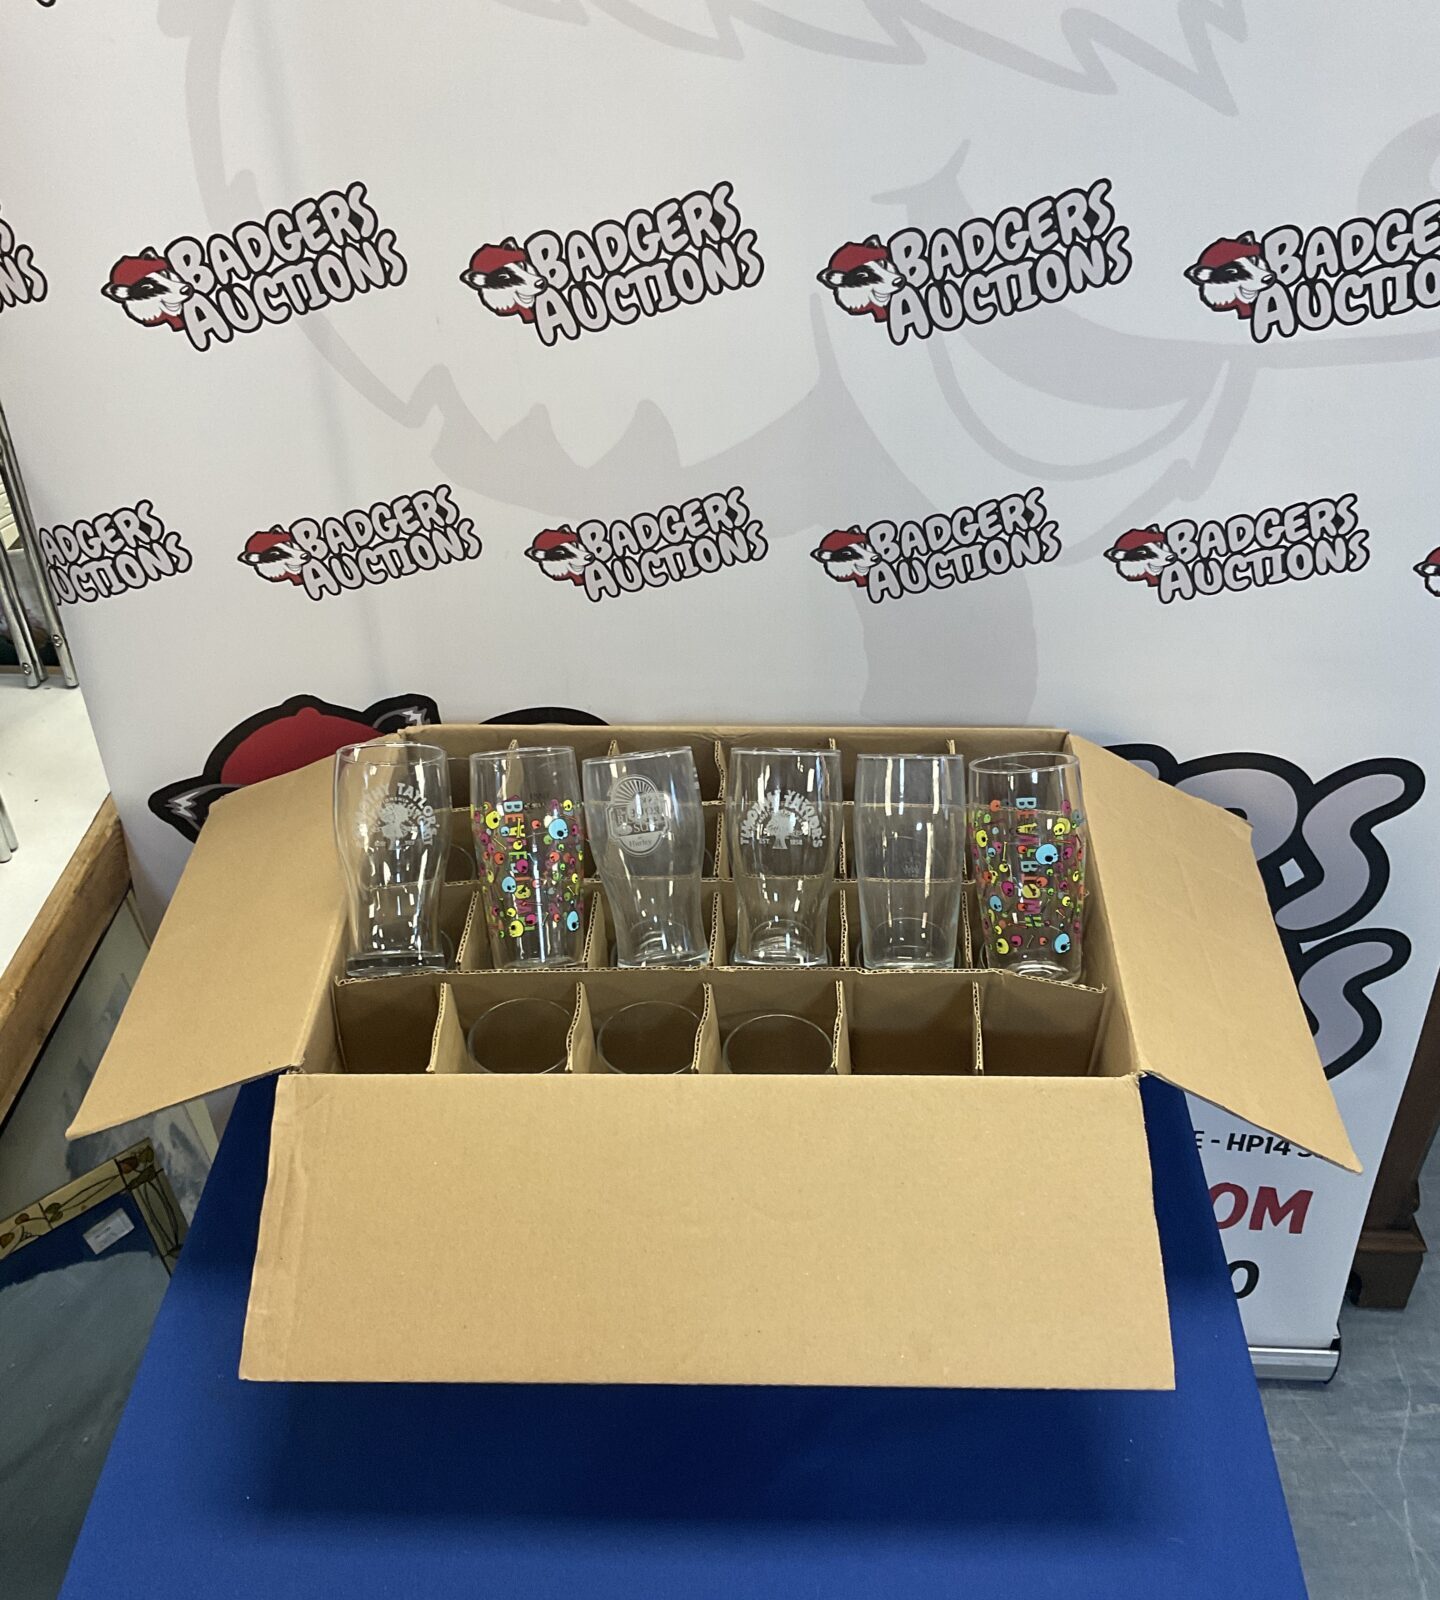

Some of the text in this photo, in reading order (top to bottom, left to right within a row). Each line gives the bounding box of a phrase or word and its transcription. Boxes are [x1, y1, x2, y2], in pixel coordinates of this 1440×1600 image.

[164, 181, 378, 296] BADGERS
[524, 181, 741, 291] BADGERS
[887, 178, 1115, 288] BADGERS
[1261, 199, 1440, 287] BADGE
[183, 228, 407, 352] AUCTIONS
[534, 229, 764, 347] AUCTIONS
[887, 226, 1132, 346] AUCTIONS
[1251, 254, 1440, 344] AUCTIO
[39, 499, 165, 566] ADGERS
[289, 484, 460, 561] BADGERS
[300, 518, 482, 601] AUCTIONS
[577, 486, 750, 563] BADGERS
[584, 520, 768, 603] AUCTIONS
[866, 487, 1047, 565] BADGERS
[867, 520, 1062, 604] AUCTIONS
[1165, 493, 1358, 564] BADGERS
[50, 531, 193, 606] UCTIONS
[1158, 529, 1370, 604] AUCTIONS
[1226, 1132, 1292, 1157] HP14
